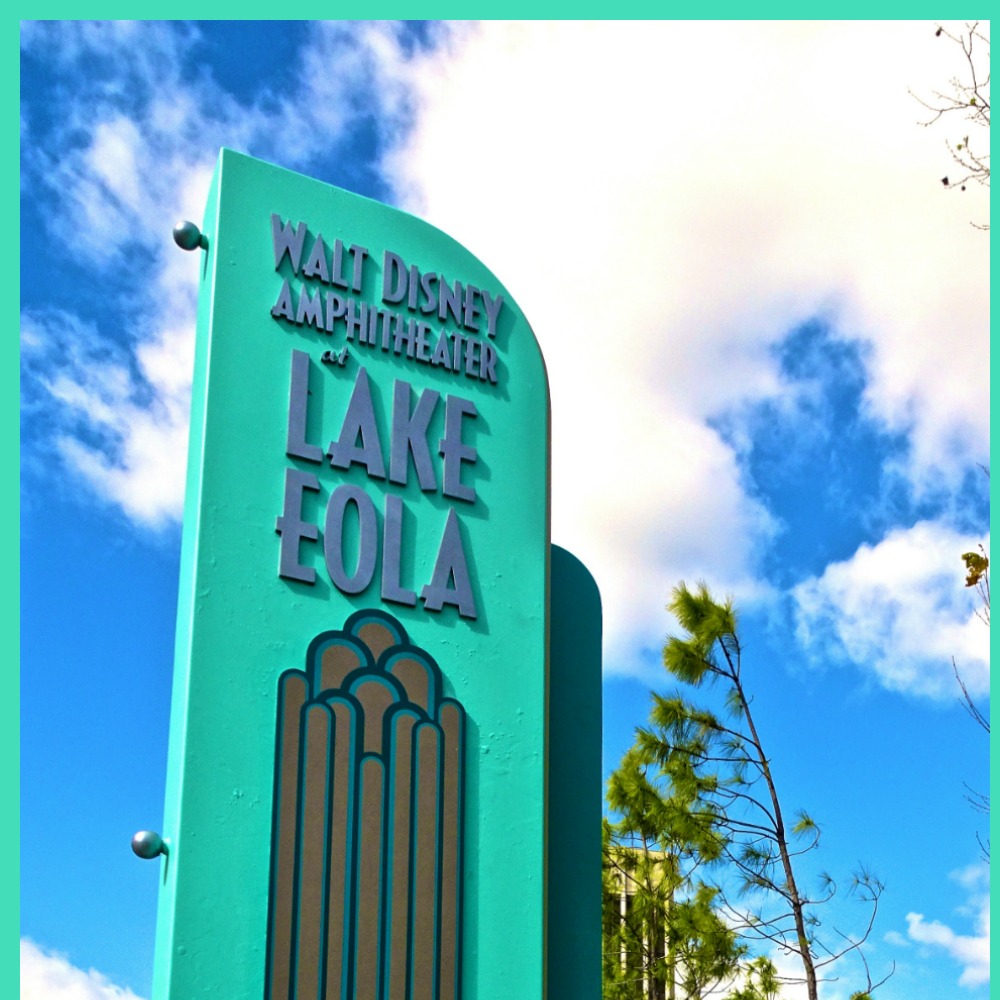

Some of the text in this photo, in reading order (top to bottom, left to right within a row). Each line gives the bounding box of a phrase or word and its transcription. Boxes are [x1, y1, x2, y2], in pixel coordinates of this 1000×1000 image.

[270, 212, 503, 338] WALT DISNEY
[271, 281, 498, 384] AMPHITHEATER
[320, 346, 348, 366] at
[286, 349, 478, 503] LAKE
[275, 467, 477, 619] EOLA
